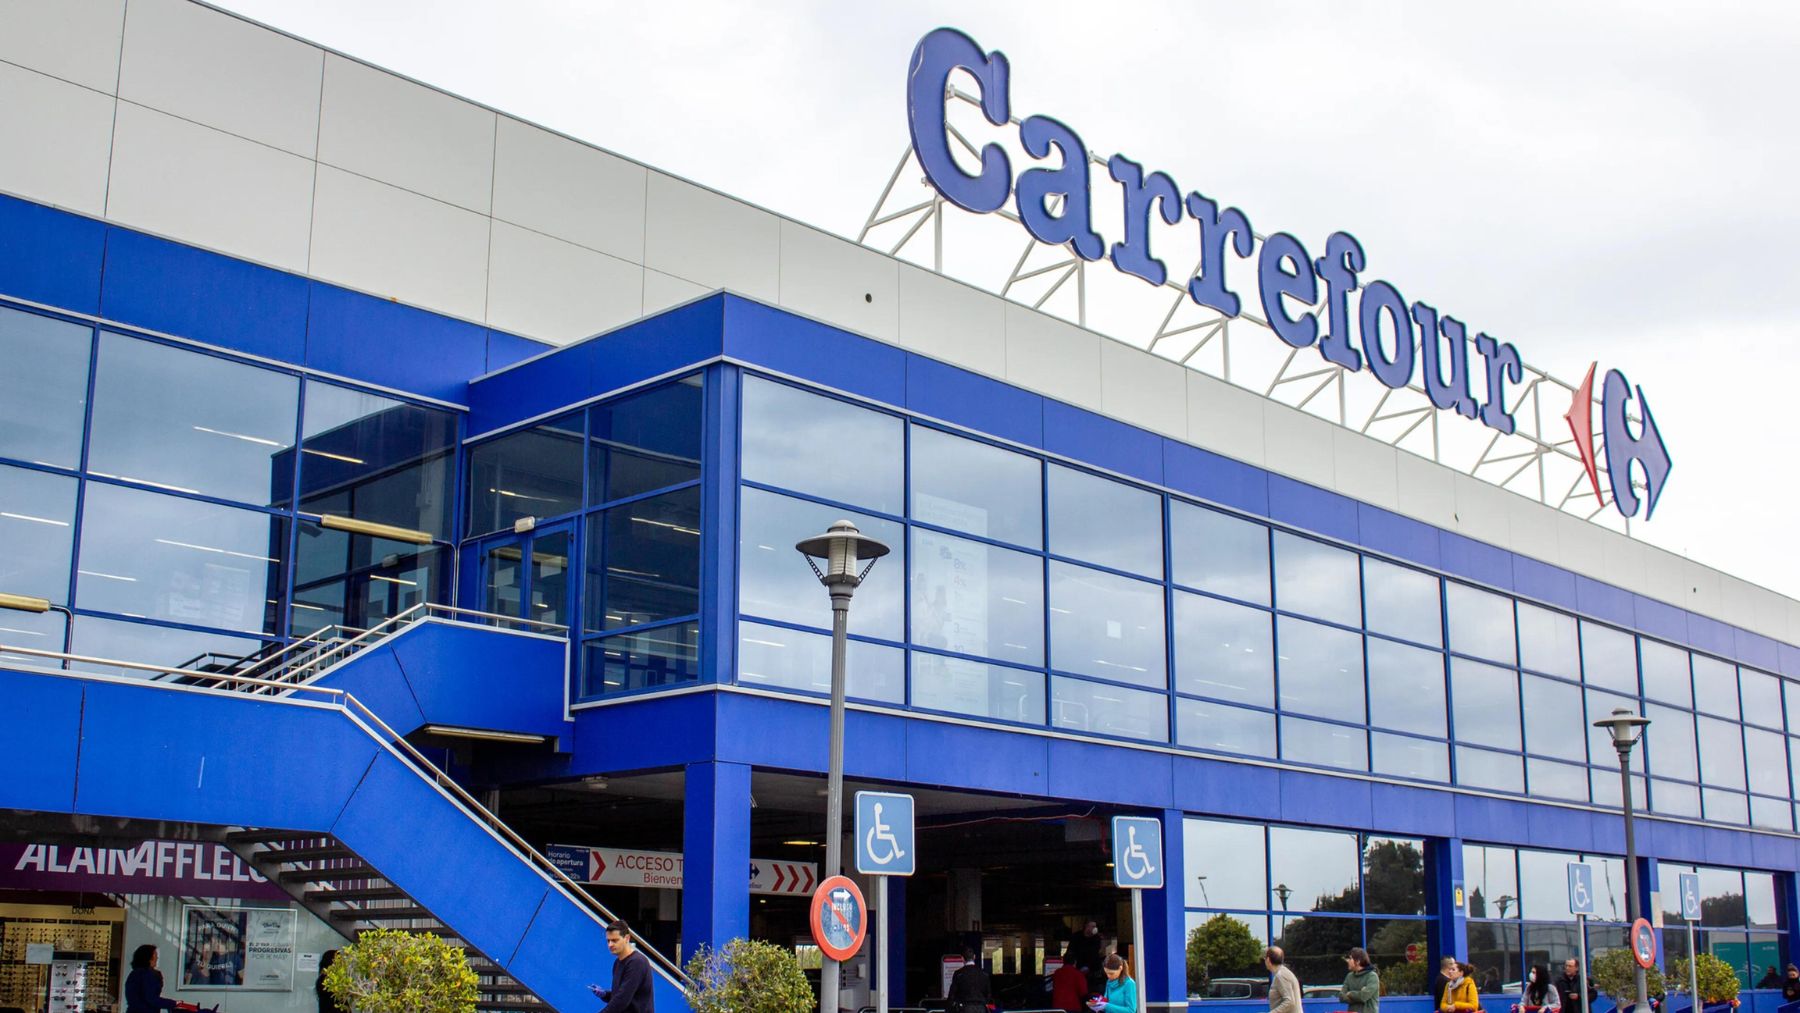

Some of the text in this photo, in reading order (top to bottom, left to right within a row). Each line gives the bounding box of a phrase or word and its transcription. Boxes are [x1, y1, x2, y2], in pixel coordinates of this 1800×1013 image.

[907, 27, 1522, 434] Carrefour
[14, 844, 135, 876] ALAIN
[615, 855, 683, 872] ACCESO T
[643, 872, 683, 885] Bienven
